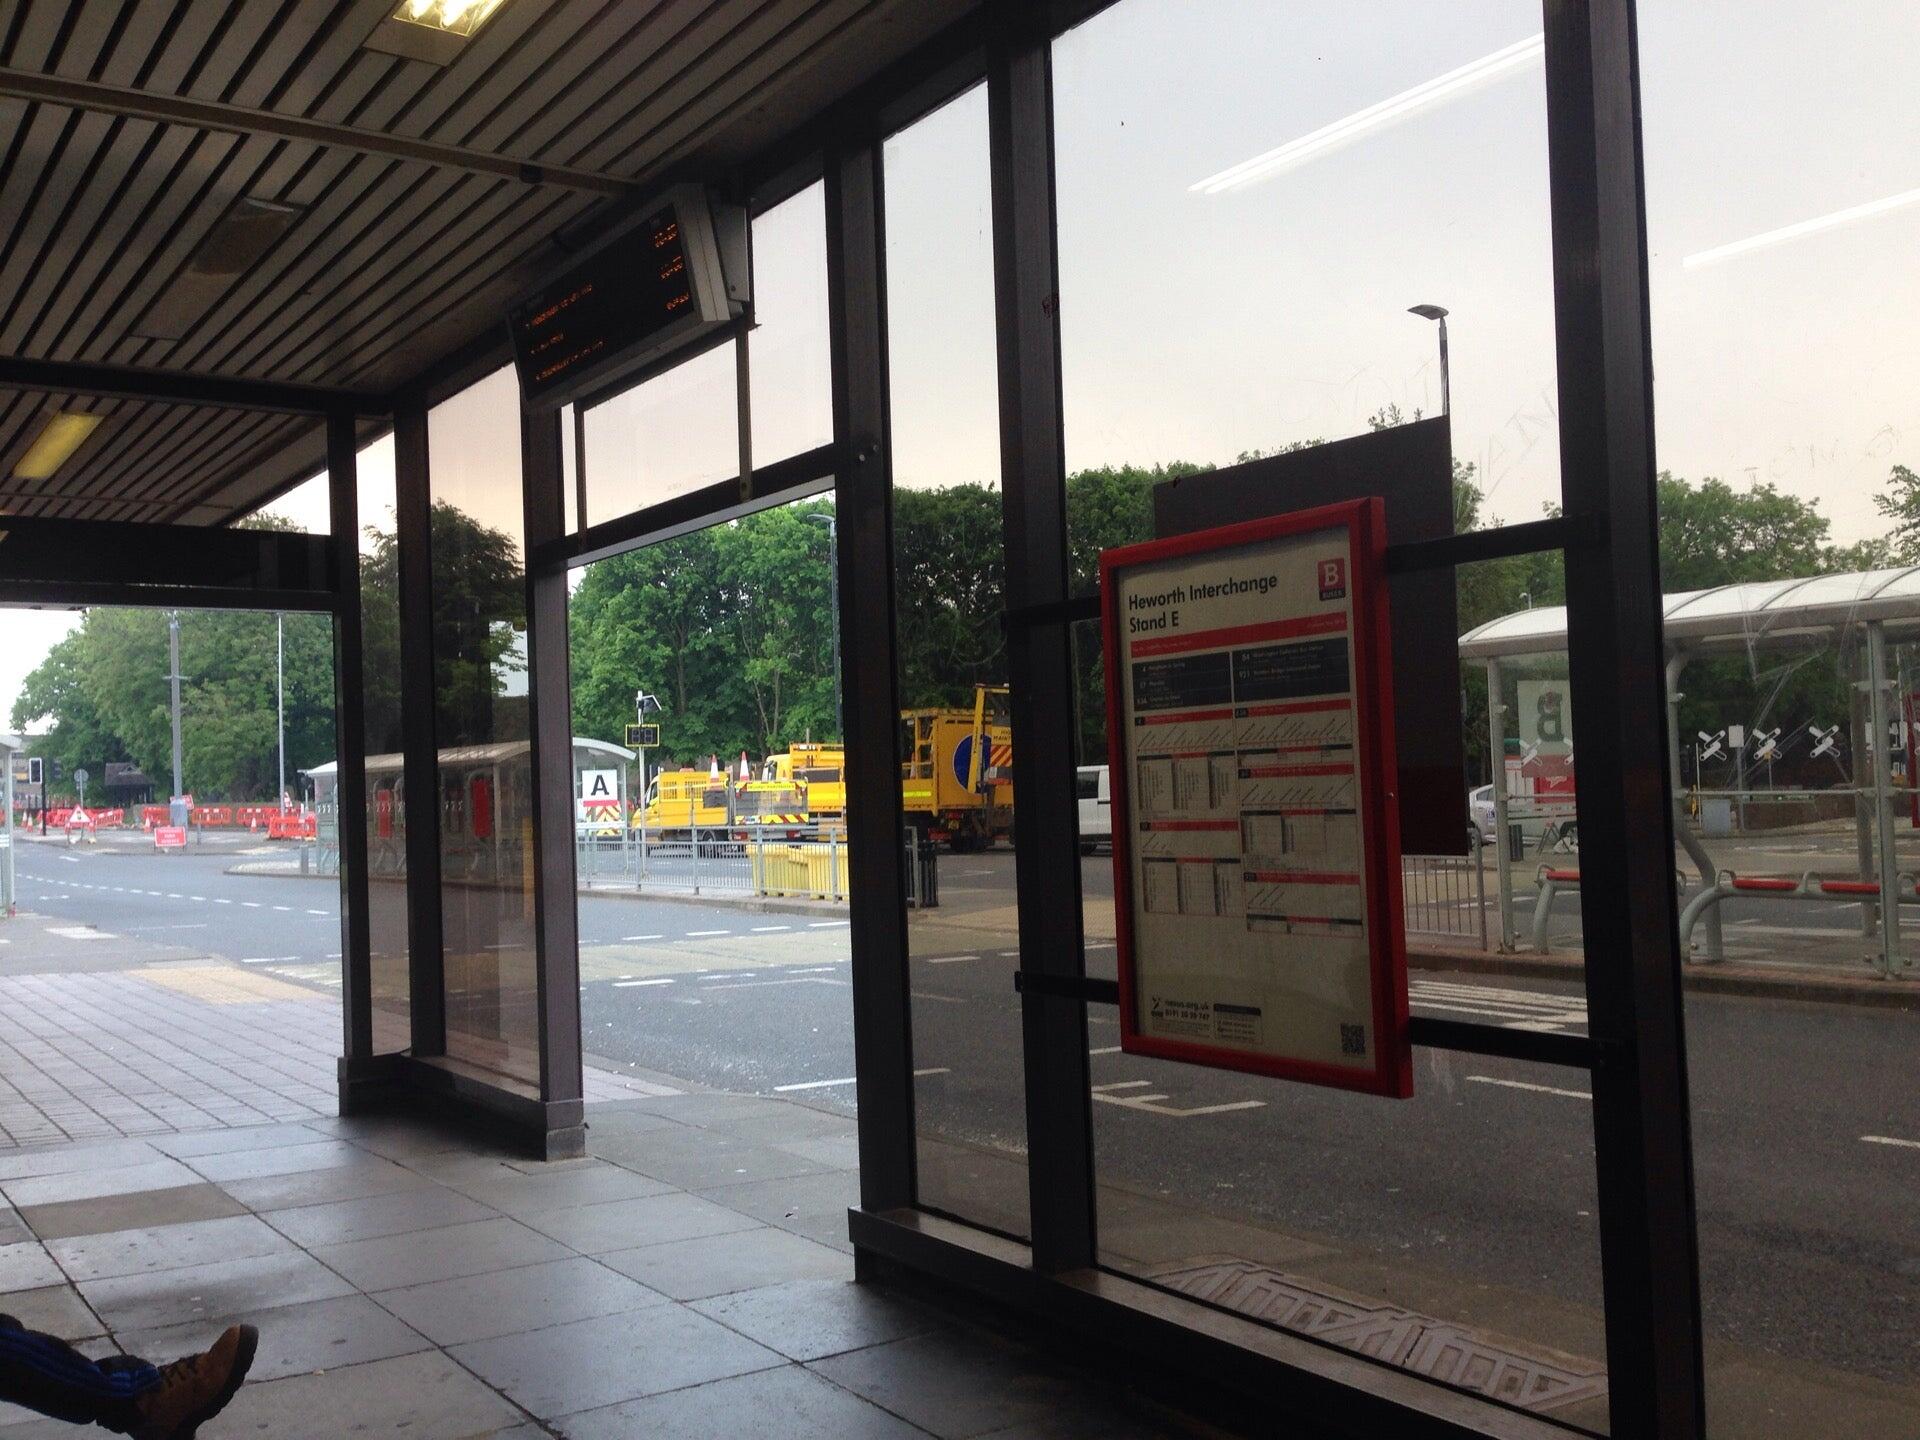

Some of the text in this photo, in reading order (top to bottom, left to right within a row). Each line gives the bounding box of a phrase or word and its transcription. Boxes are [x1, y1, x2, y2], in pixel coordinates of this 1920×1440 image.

[1324, 564, 1339, 586] B
[1128, 573, 1278, 611] Heworth Interchange
[1129, 610, 1180, 634] Stand E
[591, 775, 610, 795] A
